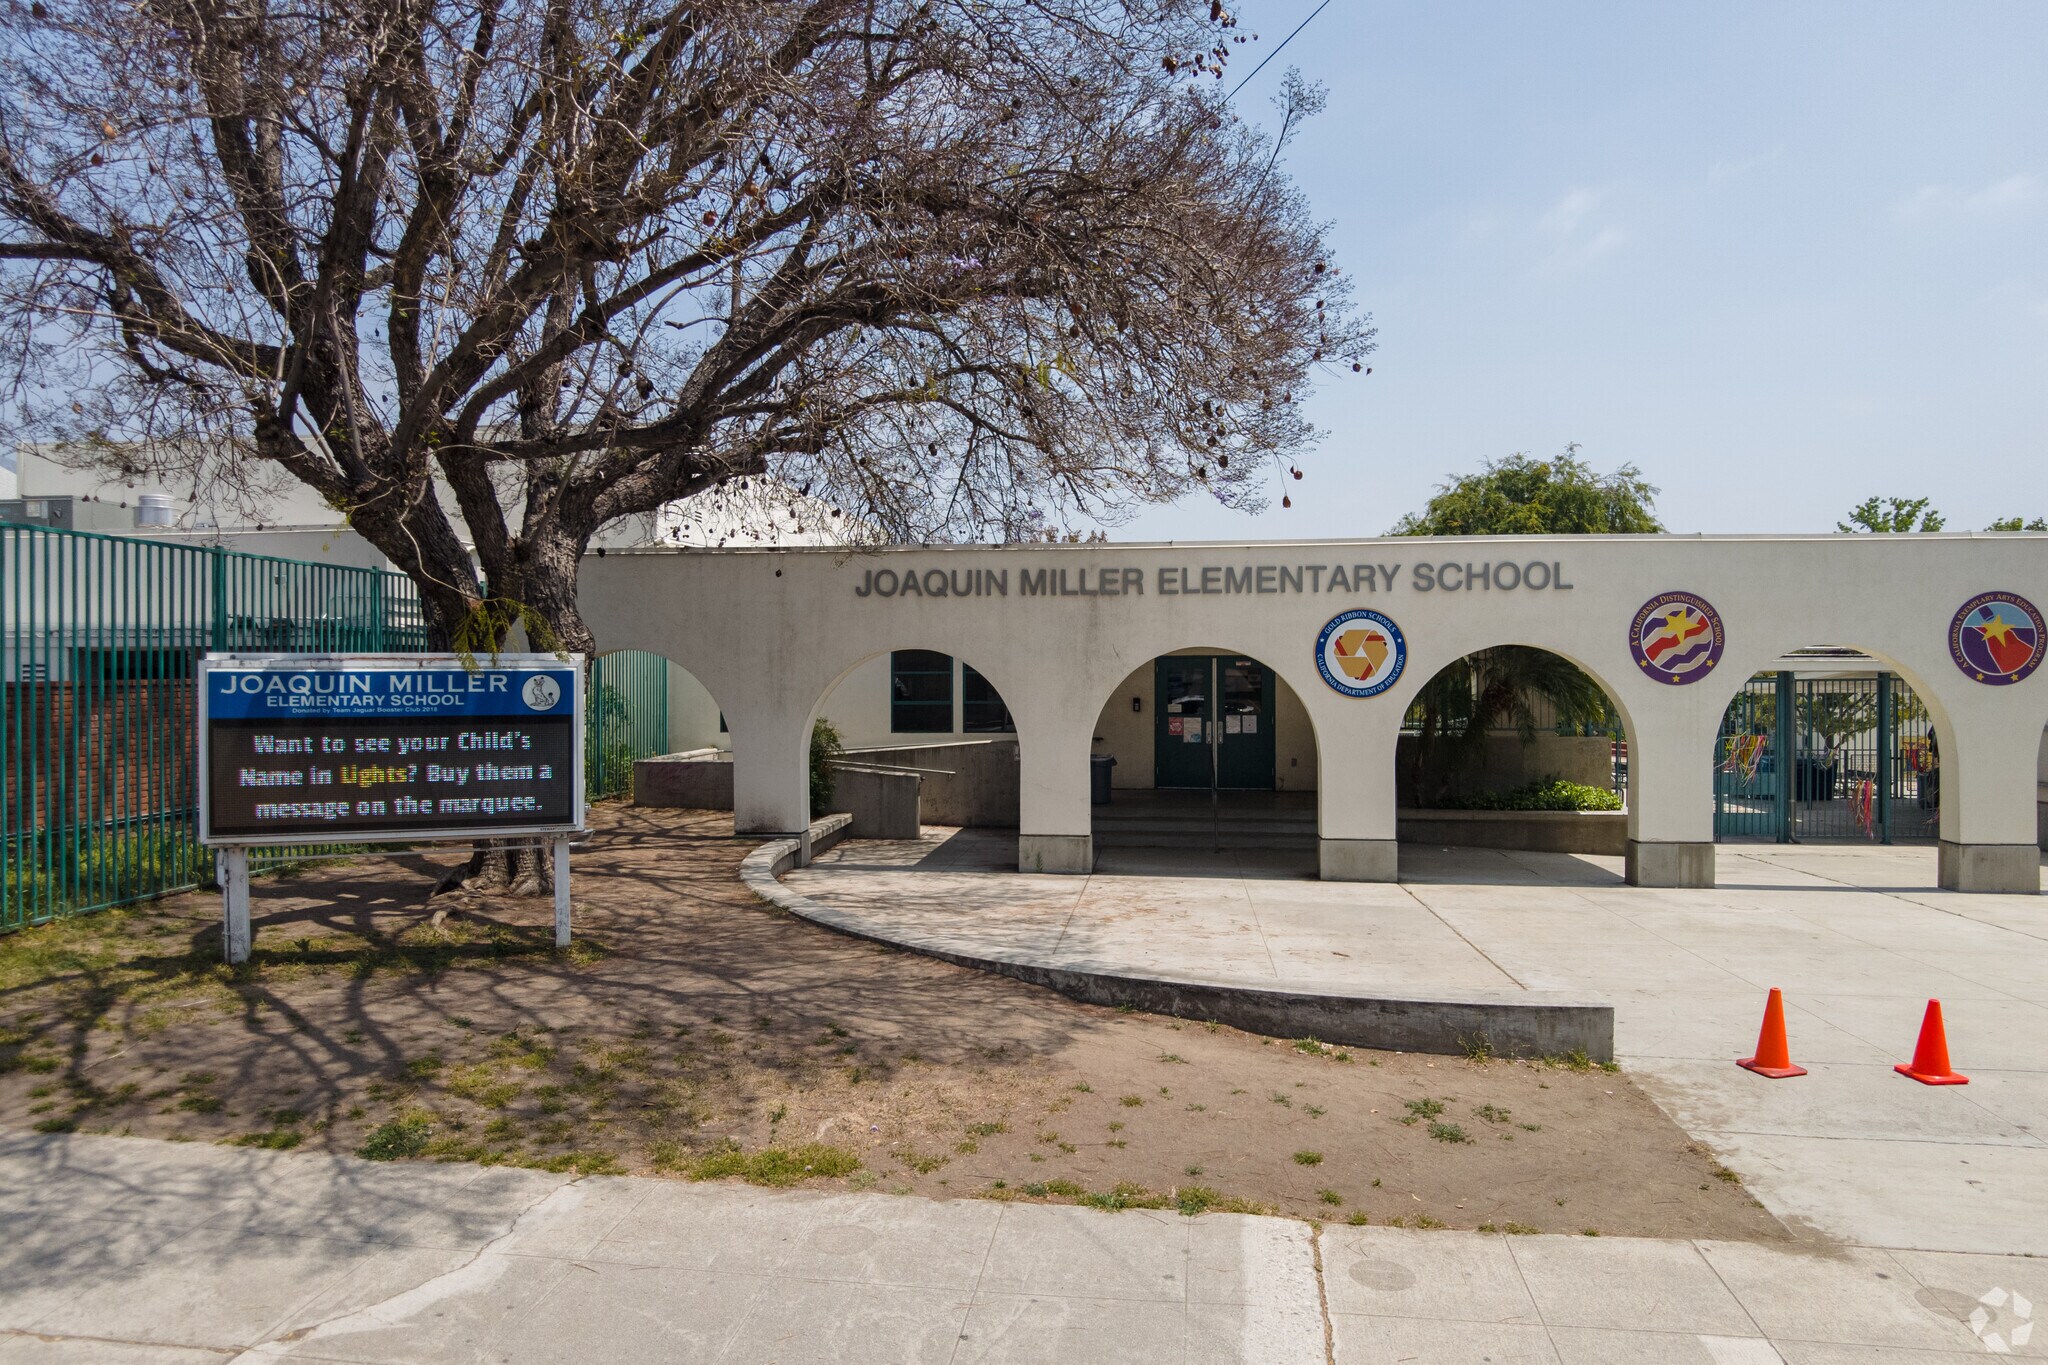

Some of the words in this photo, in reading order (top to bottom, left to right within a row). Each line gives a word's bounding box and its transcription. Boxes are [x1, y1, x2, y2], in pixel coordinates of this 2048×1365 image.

[855, 568, 1008, 598] JOAQUIN
[1020, 567, 1144, 597] MILLER
[1158, 564, 1402, 596] ELEMENTARY
[1412, 561, 1574, 592] SCHOOL
[1324, 618, 1340, 634] GOLD
[1341, 611, 1366, 621] RIBBON
[1368, 612, 1396, 632] SCHOOLS
[1631, 601, 1659, 638] CALIFORNIA
[1660, 594, 1714, 617] DISTINGUISHED
[1711, 616, 1722, 646] SCHOOL
[220, 674, 370, 696] JOAQUIN
[389, 674, 508, 693] MILLER
[1317, 654, 1336, 688] CALIFORNIA
[1337, 684, 1376, 696] DEPARTMENT
[1386, 654, 1404, 684] EDUCATION
[267, 695, 386, 707] ELEMENTARY
[390, 694, 464, 706] SCHOOL
[254, 736, 313, 754] Want
[322, 736, 346, 753] to
[354, 738, 391, 753] see
[397, 736, 449, 755] your
[458, 732, 532, 751] Child's
[240, 767, 303, 786] Name
[310, 765, 332, 785] in
[340, 763, 418, 788] Lights?
[426, 763, 470, 786] Buy
[475, 762, 533, 781] them
[538, 764, 552, 779] a
[255, 801, 350, 820] message
[356, 801, 386, 816] on
[394, 796, 432, 815] the
[438, 796, 543, 815] marquee.
